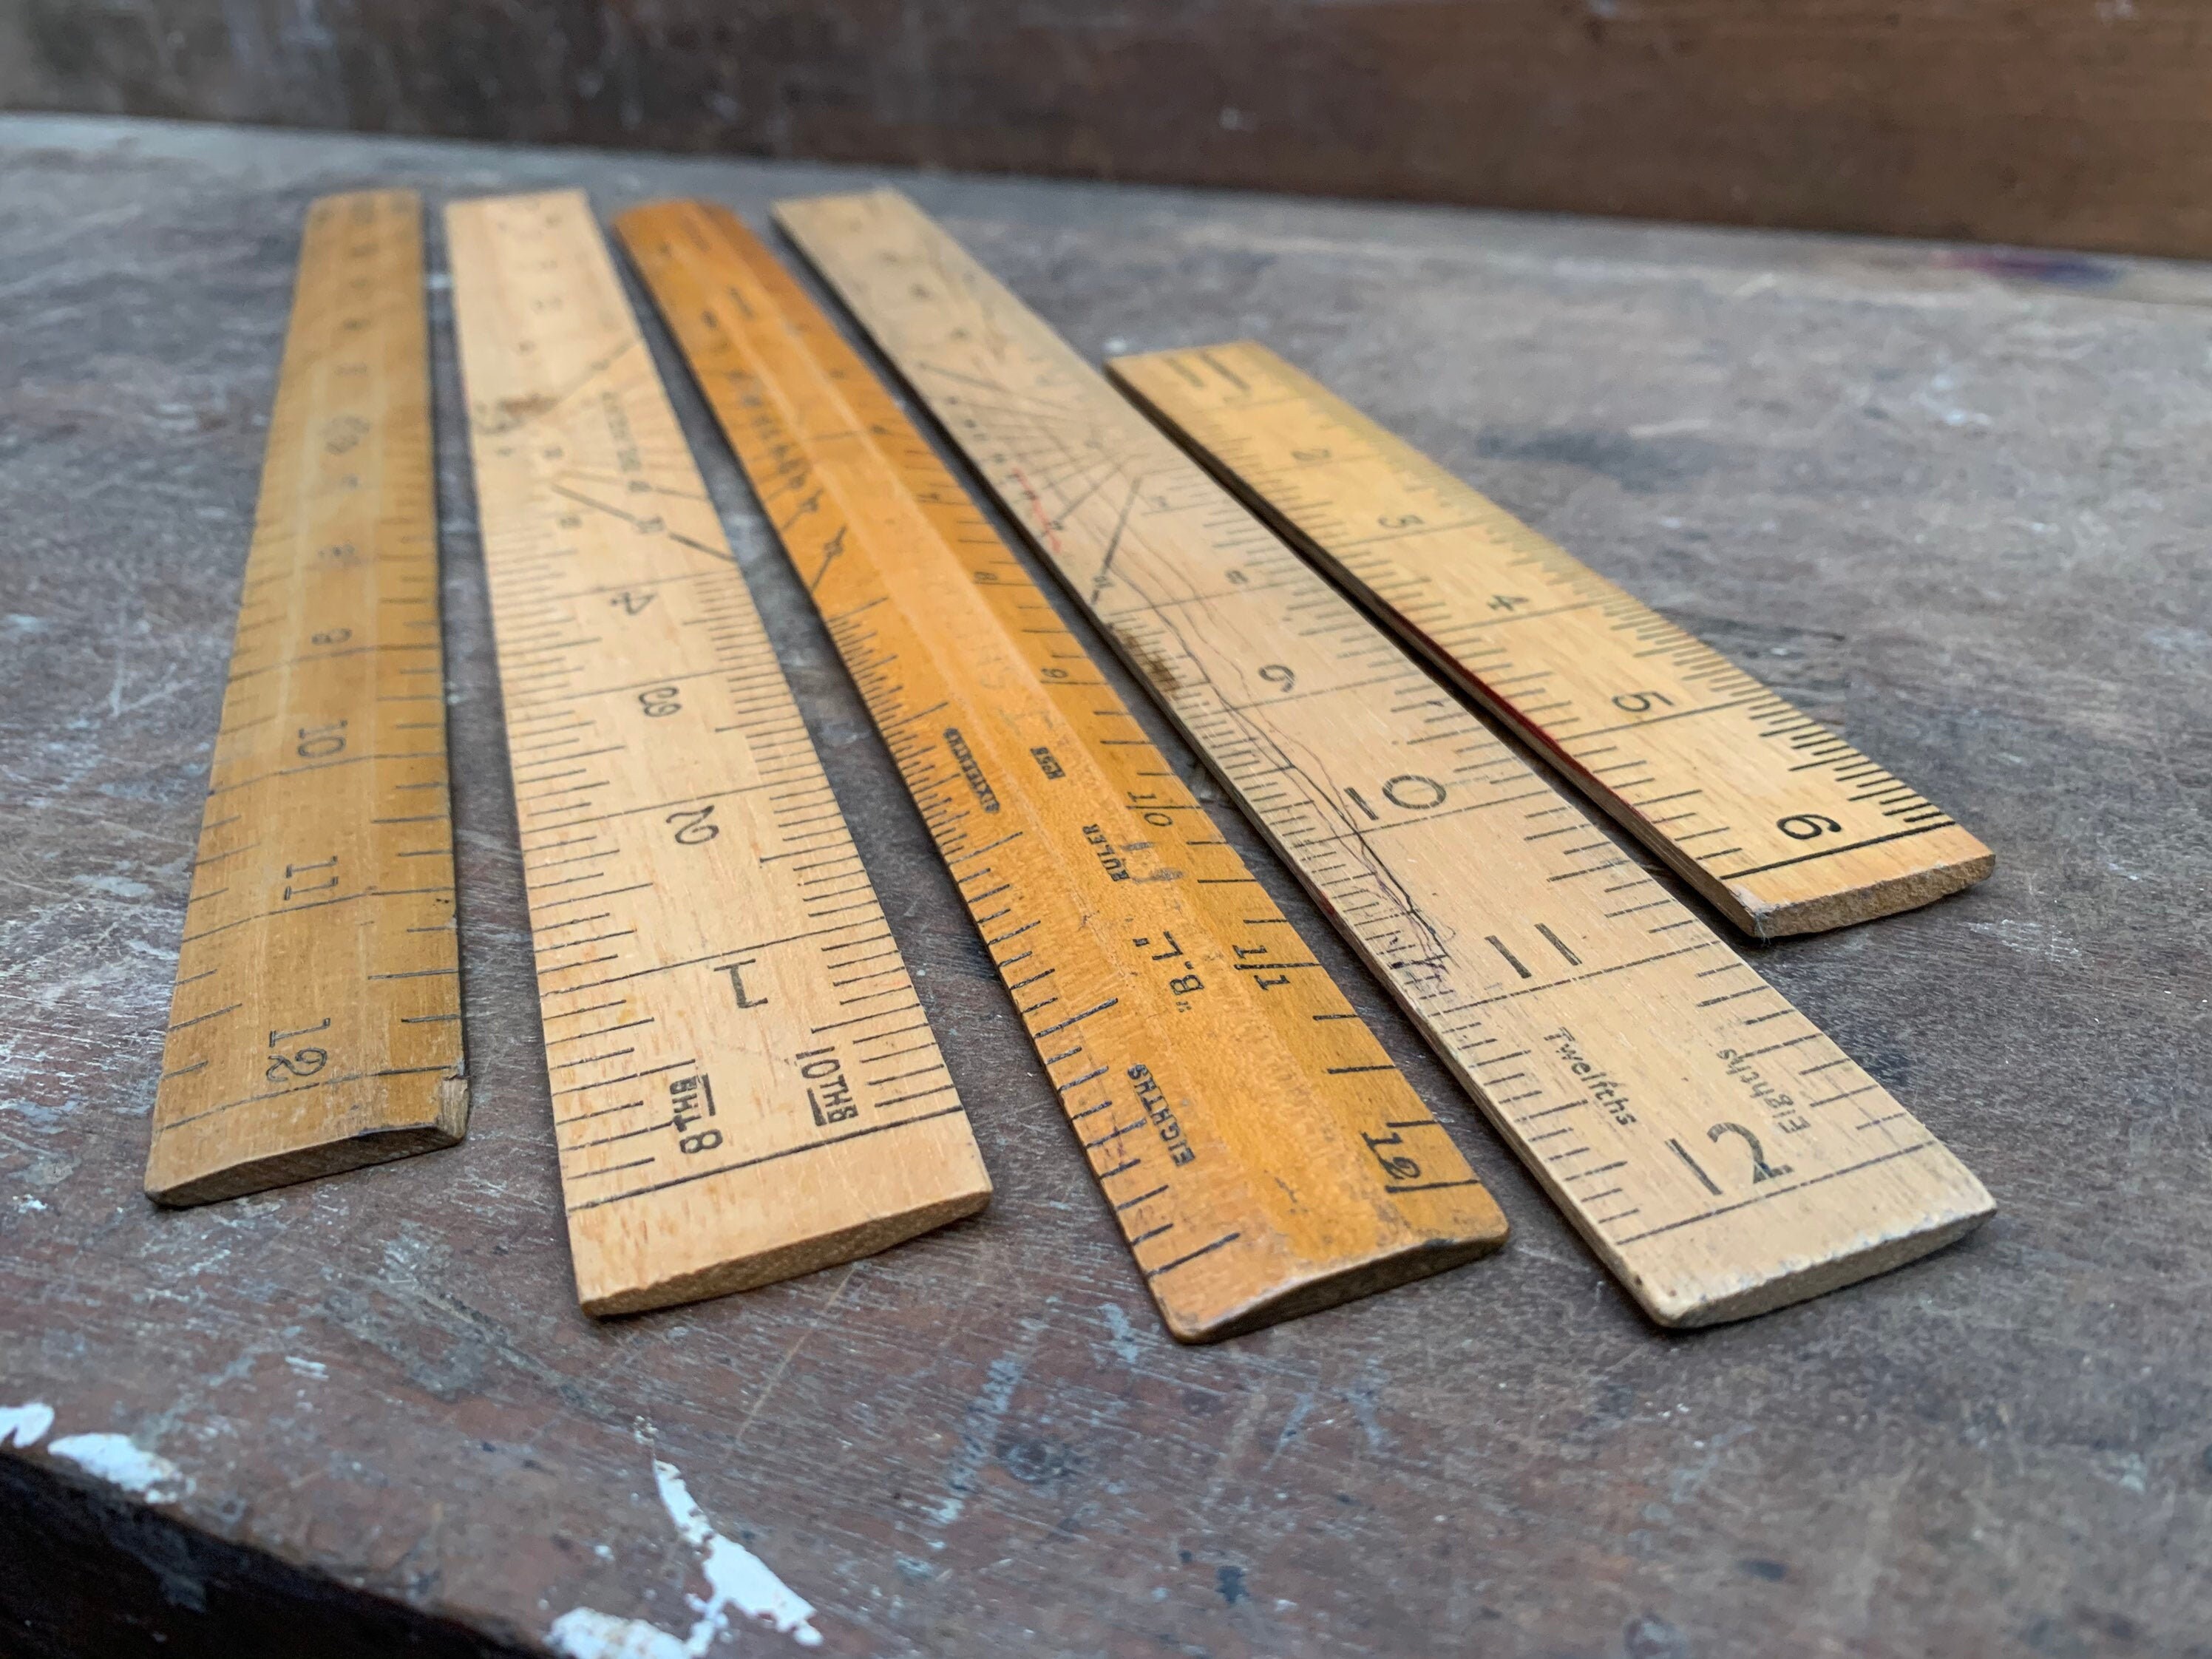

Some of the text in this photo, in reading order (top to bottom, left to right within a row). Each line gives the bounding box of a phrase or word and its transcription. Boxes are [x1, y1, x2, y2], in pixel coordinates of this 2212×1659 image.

[1486, 594, 1530, 612] 4
[1258, 663, 1297, 693] 9
[638, 686, 683, 718] 3
[1611, 690, 1675, 714] 5
[297, 719, 348, 758] 10
[1127, 791, 1174, 827] 10
[1343, 774, 1448, 821] 10
[665, 803, 720, 846] 2
[1776, 813, 1843, 841] 6
[1082, 823, 1131, 882] RULER
[283, 855, 339, 901] 11
[1232, 944, 1291, 991] 11
[1485, 922, 1583, 979] 11
[713, 957, 769, 1009] 1
[266, 1017, 331, 1083] 12
[795, 1045, 859, 1124] 10THS
[1543, 1026, 1638, 1126] Twelfths
[1716, 1048, 1812, 1135] Eighths
[1127, 1063, 1196, 1167] EIGHTHS
[1360, 1130, 1422, 1181] 12
[1663, 1122, 1795, 1196] 12
